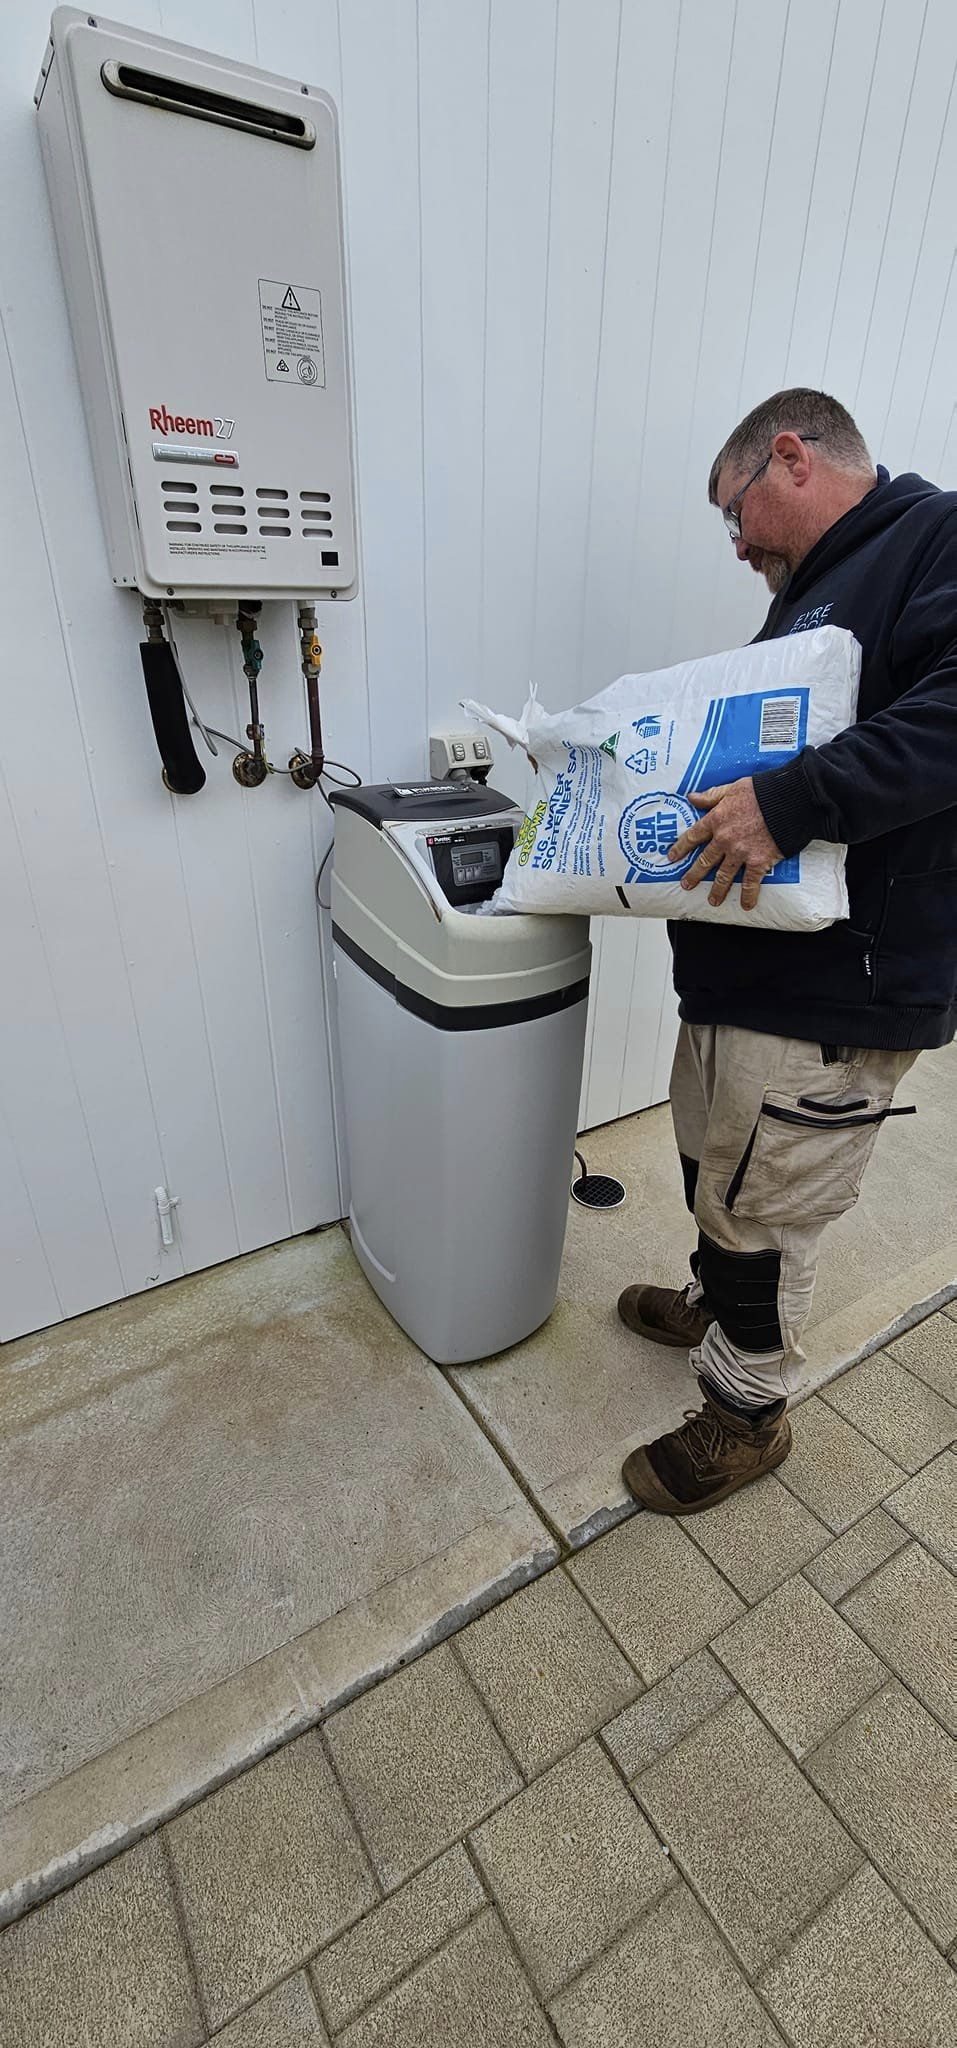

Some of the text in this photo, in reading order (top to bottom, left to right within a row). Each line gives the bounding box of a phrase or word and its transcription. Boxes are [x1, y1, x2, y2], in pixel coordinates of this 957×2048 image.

[148, 404, 236, 440] Rheem 27
[794, 602, 834, 627] EYRE
[650, 750, 658, 771] LDPE
[518, 799, 548, 867] CROWN
[531, 836, 551, 869] H.G.
[545, 772, 565, 831] WATER
[541, 779, 573, 871] SOFTENER
[656, 811, 678, 856] SALT
[664, 798, 693, 828] AUSTRALIAN
[623, 812, 654, 869] AUSTRALIAN NATURAL
[635, 816, 657, 854] SEA
